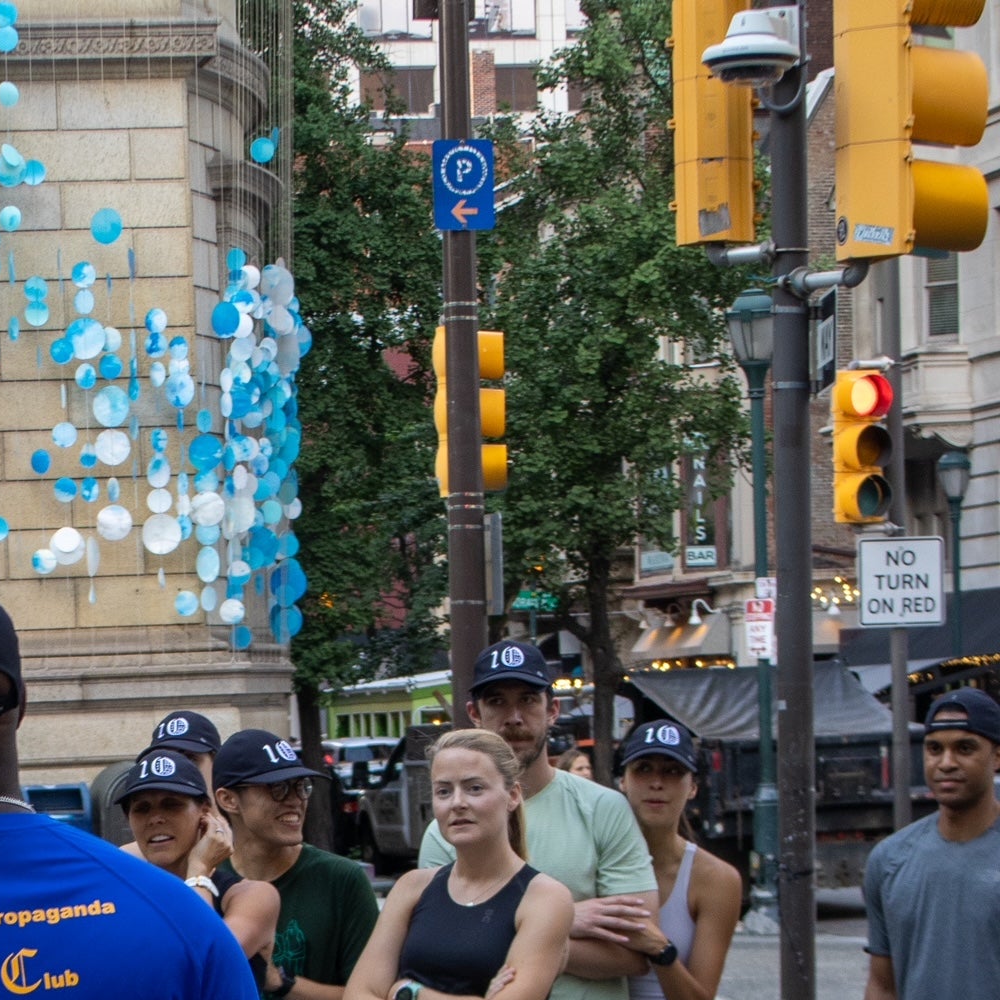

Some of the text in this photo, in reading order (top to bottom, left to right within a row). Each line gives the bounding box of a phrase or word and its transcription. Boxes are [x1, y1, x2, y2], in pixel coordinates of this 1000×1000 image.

[456, 158, 473, 183] P
[693, 456, 707, 541] NAILS
[687, 550, 714, 561] BAR
[885, 550, 916, 567] NO
[873, 573, 929, 590] TURN
[867, 597, 936, 615] ON RED
[0, 948, 79, 995] Club
